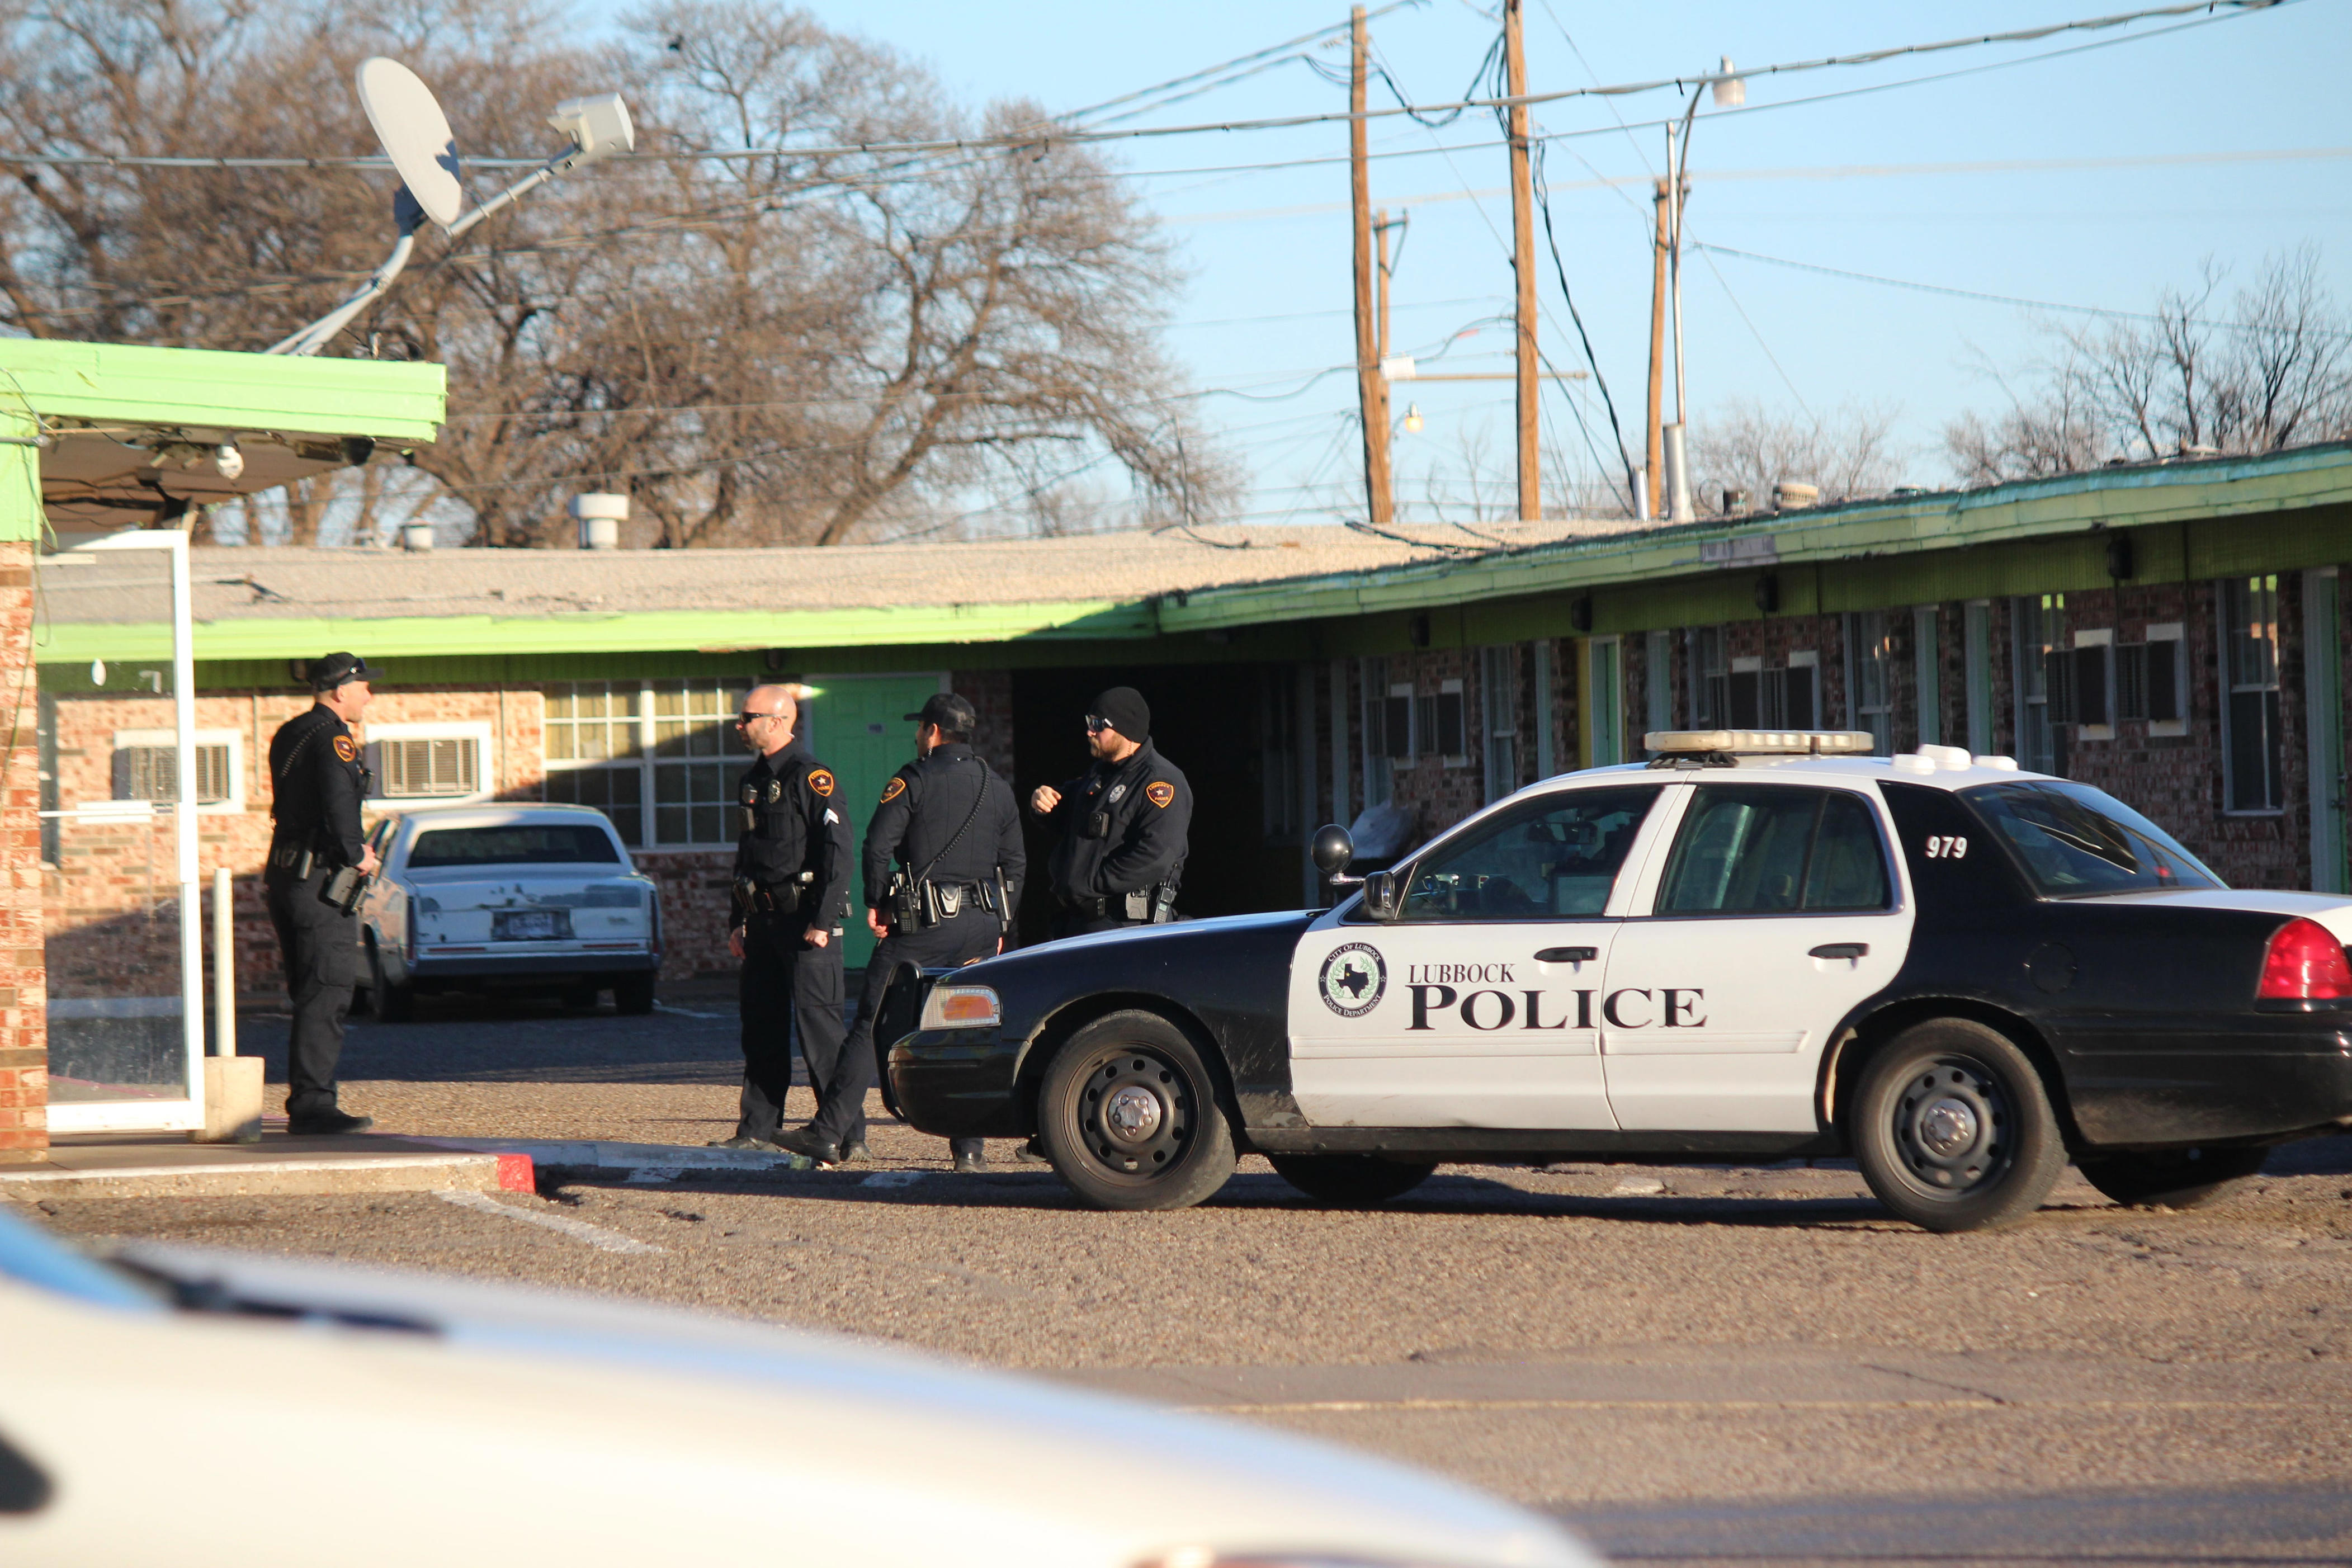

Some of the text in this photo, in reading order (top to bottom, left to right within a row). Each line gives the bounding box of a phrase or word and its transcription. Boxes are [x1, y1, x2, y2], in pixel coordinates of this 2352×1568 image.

[1925, 835, 1968, 859] 979
[1328, 948, 1343, 962] CITY
[1354, 943, 1381, 962] LUBBOCK
[1408, 962, 1516, 984] LUBBOCK
[1323, 994, 1381, 1017] POLICE DEPARTMENT
[1404, 984, 1709, 1031] POLICE
